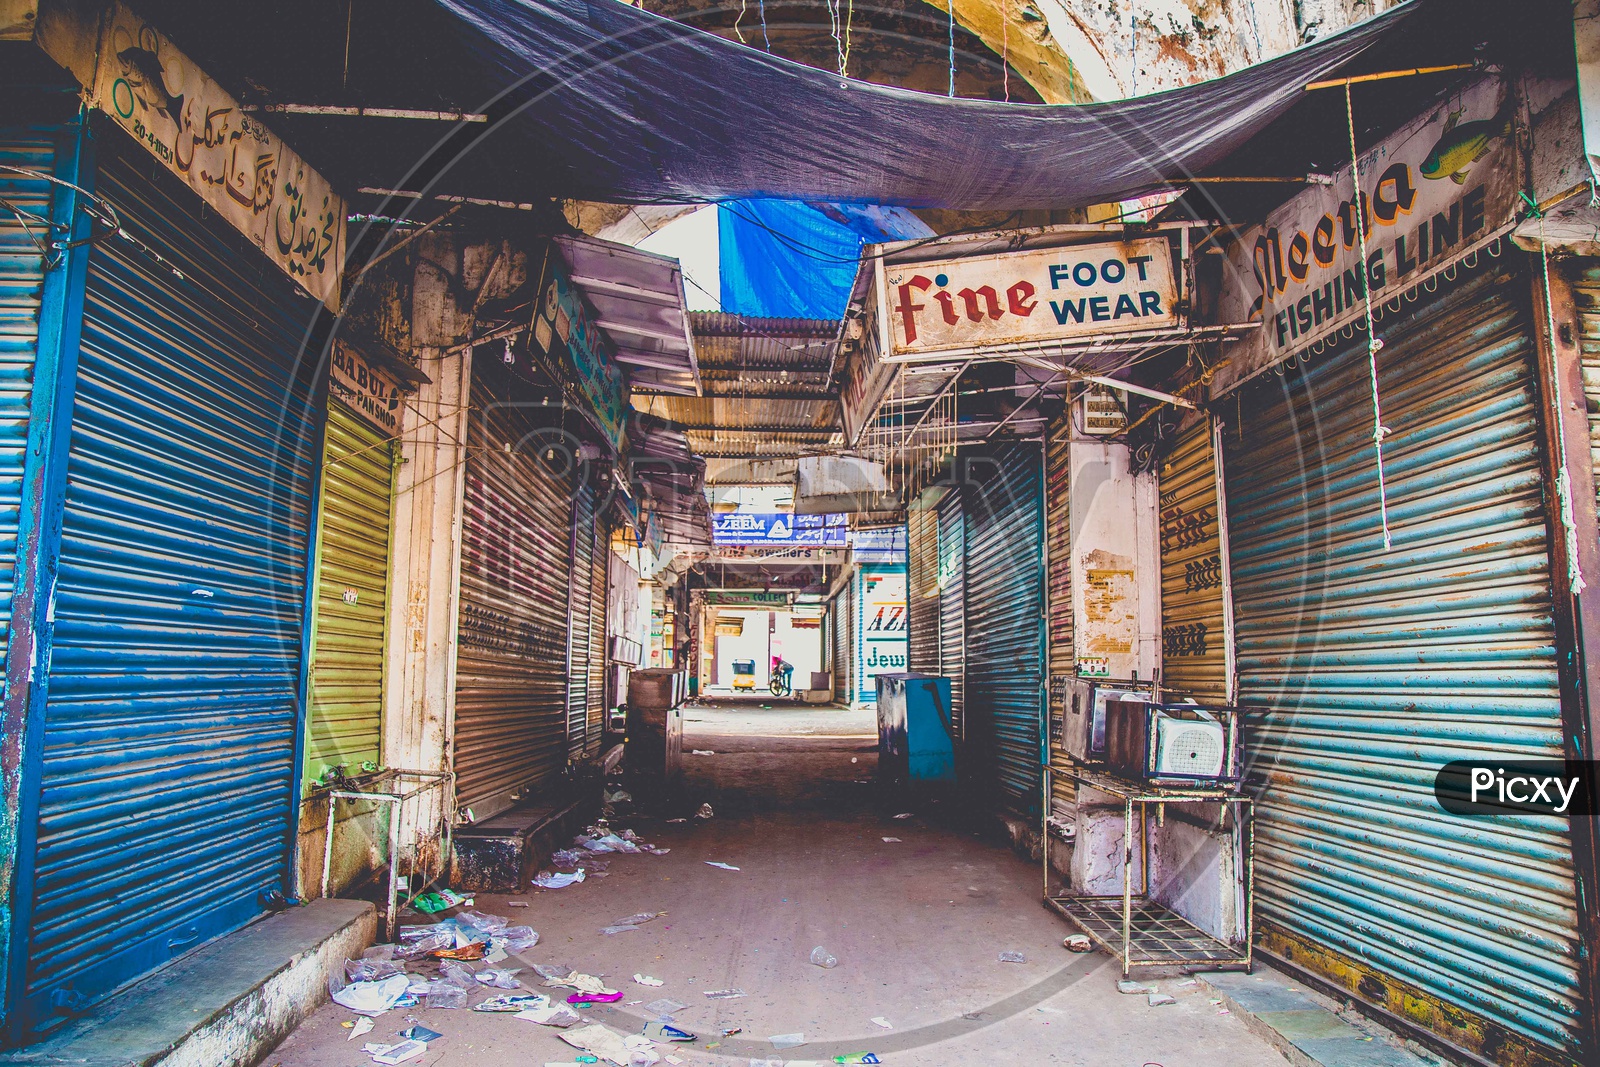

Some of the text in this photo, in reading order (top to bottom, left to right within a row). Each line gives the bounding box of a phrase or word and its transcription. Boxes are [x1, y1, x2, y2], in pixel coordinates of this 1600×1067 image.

[1248, 162, 1418, 322] Meena
[1275, 183, 1485, 349] FISHING LINE
[1048, 255, 1153, 290] FOOT
[895, 274, 1039, 346] fine
[1049, 291, 1164, 326] WEAR
[333, 344, 388, 404] BABUL
[357, 389, 375, 416] PAN
[375, 403, 397, 429] SHOP
[712, 519, 766, 530] AZEEM
